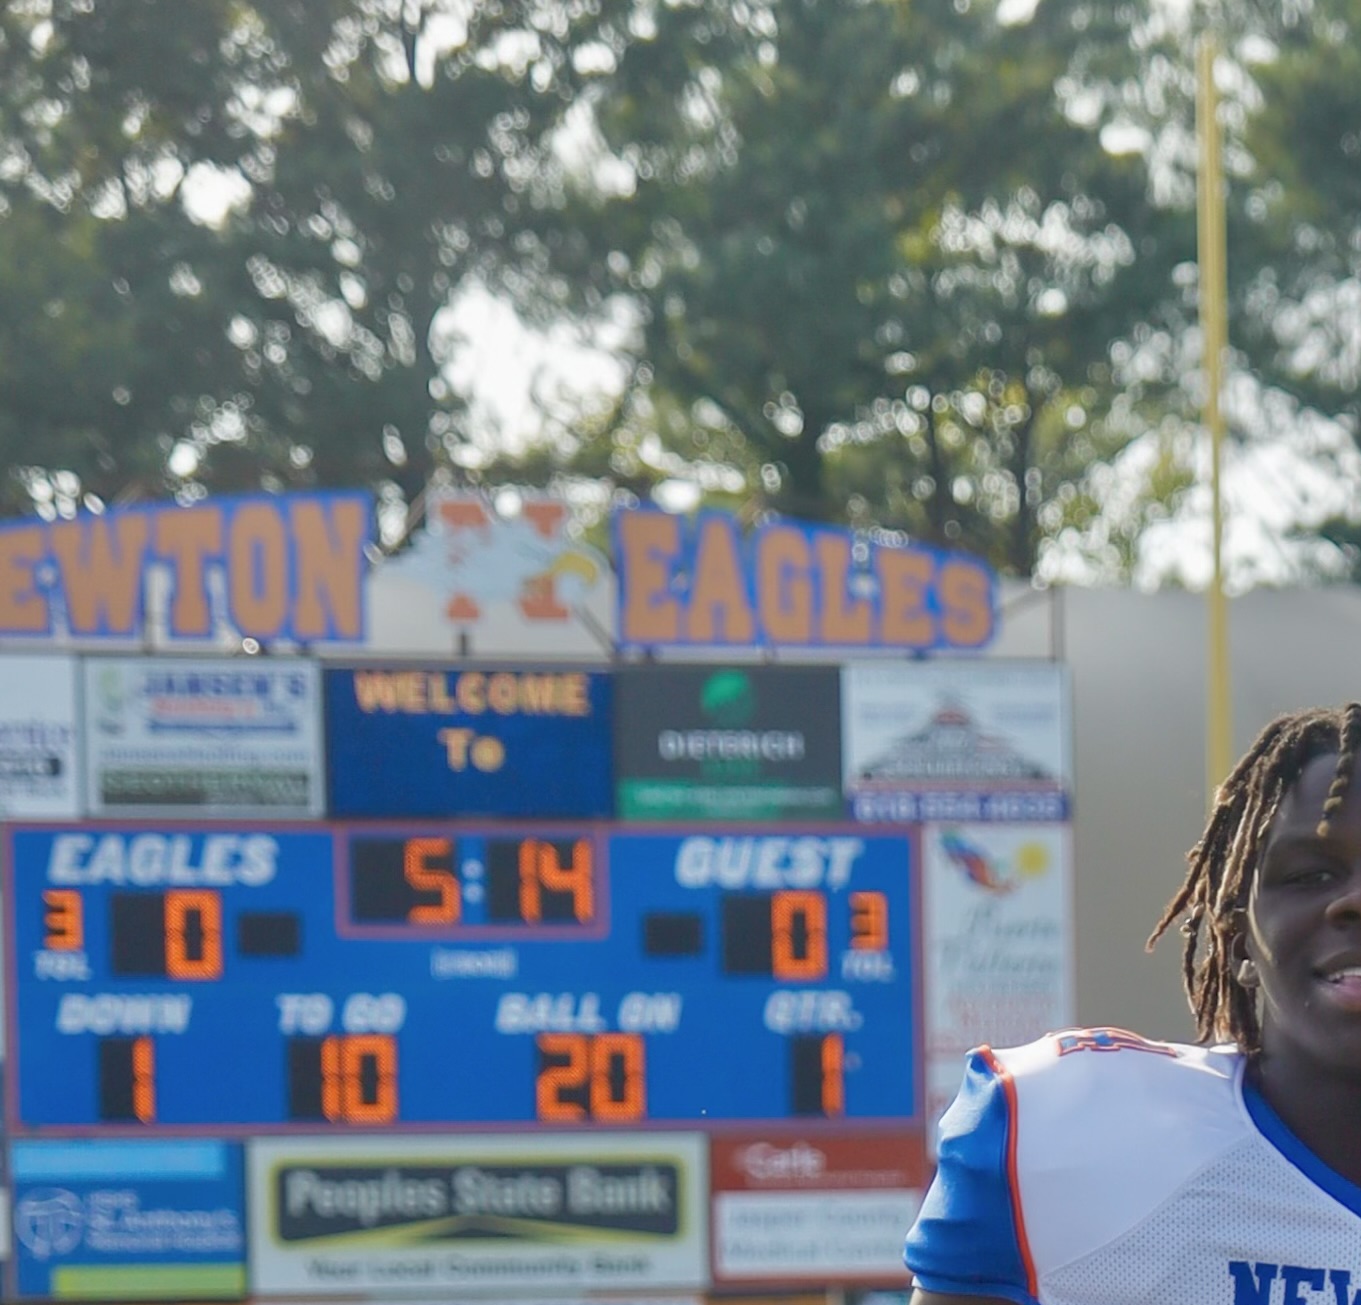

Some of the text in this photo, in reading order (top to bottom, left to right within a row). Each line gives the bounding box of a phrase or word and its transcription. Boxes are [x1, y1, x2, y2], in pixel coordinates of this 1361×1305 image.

[620, 510, 992, 648] EAGLES
[354, 672, 588, 715] WELCOME
[440, 728, 505, 772] To
[48, 834, 278, 885] EAGLES
[404, 837, 595, 926] 5:14
[676, 837, 862, 888] GUEST
[43, 890, 83, 950] 3
[165, 890, 222, 980] 0
[771, 890, 827, 981] 0
[850, 891, 888, 951] 3
[57, 993, 192, 1035] DOWN
[277, 993, 406, 1034] TO GO
[496, 992, 682, 1034] BALL ON
[133, 1035, 155, 1124] 1
[320, 1034, 397, 1124] 10
[537, 1033, 646, 1123] 20
[821, 1033, 843, 1117] 1
[284, 1168, 448, 1228] Peoples
[452, 1166, 562, 1216] State
[566, 1165, 672, 1216] Bank
